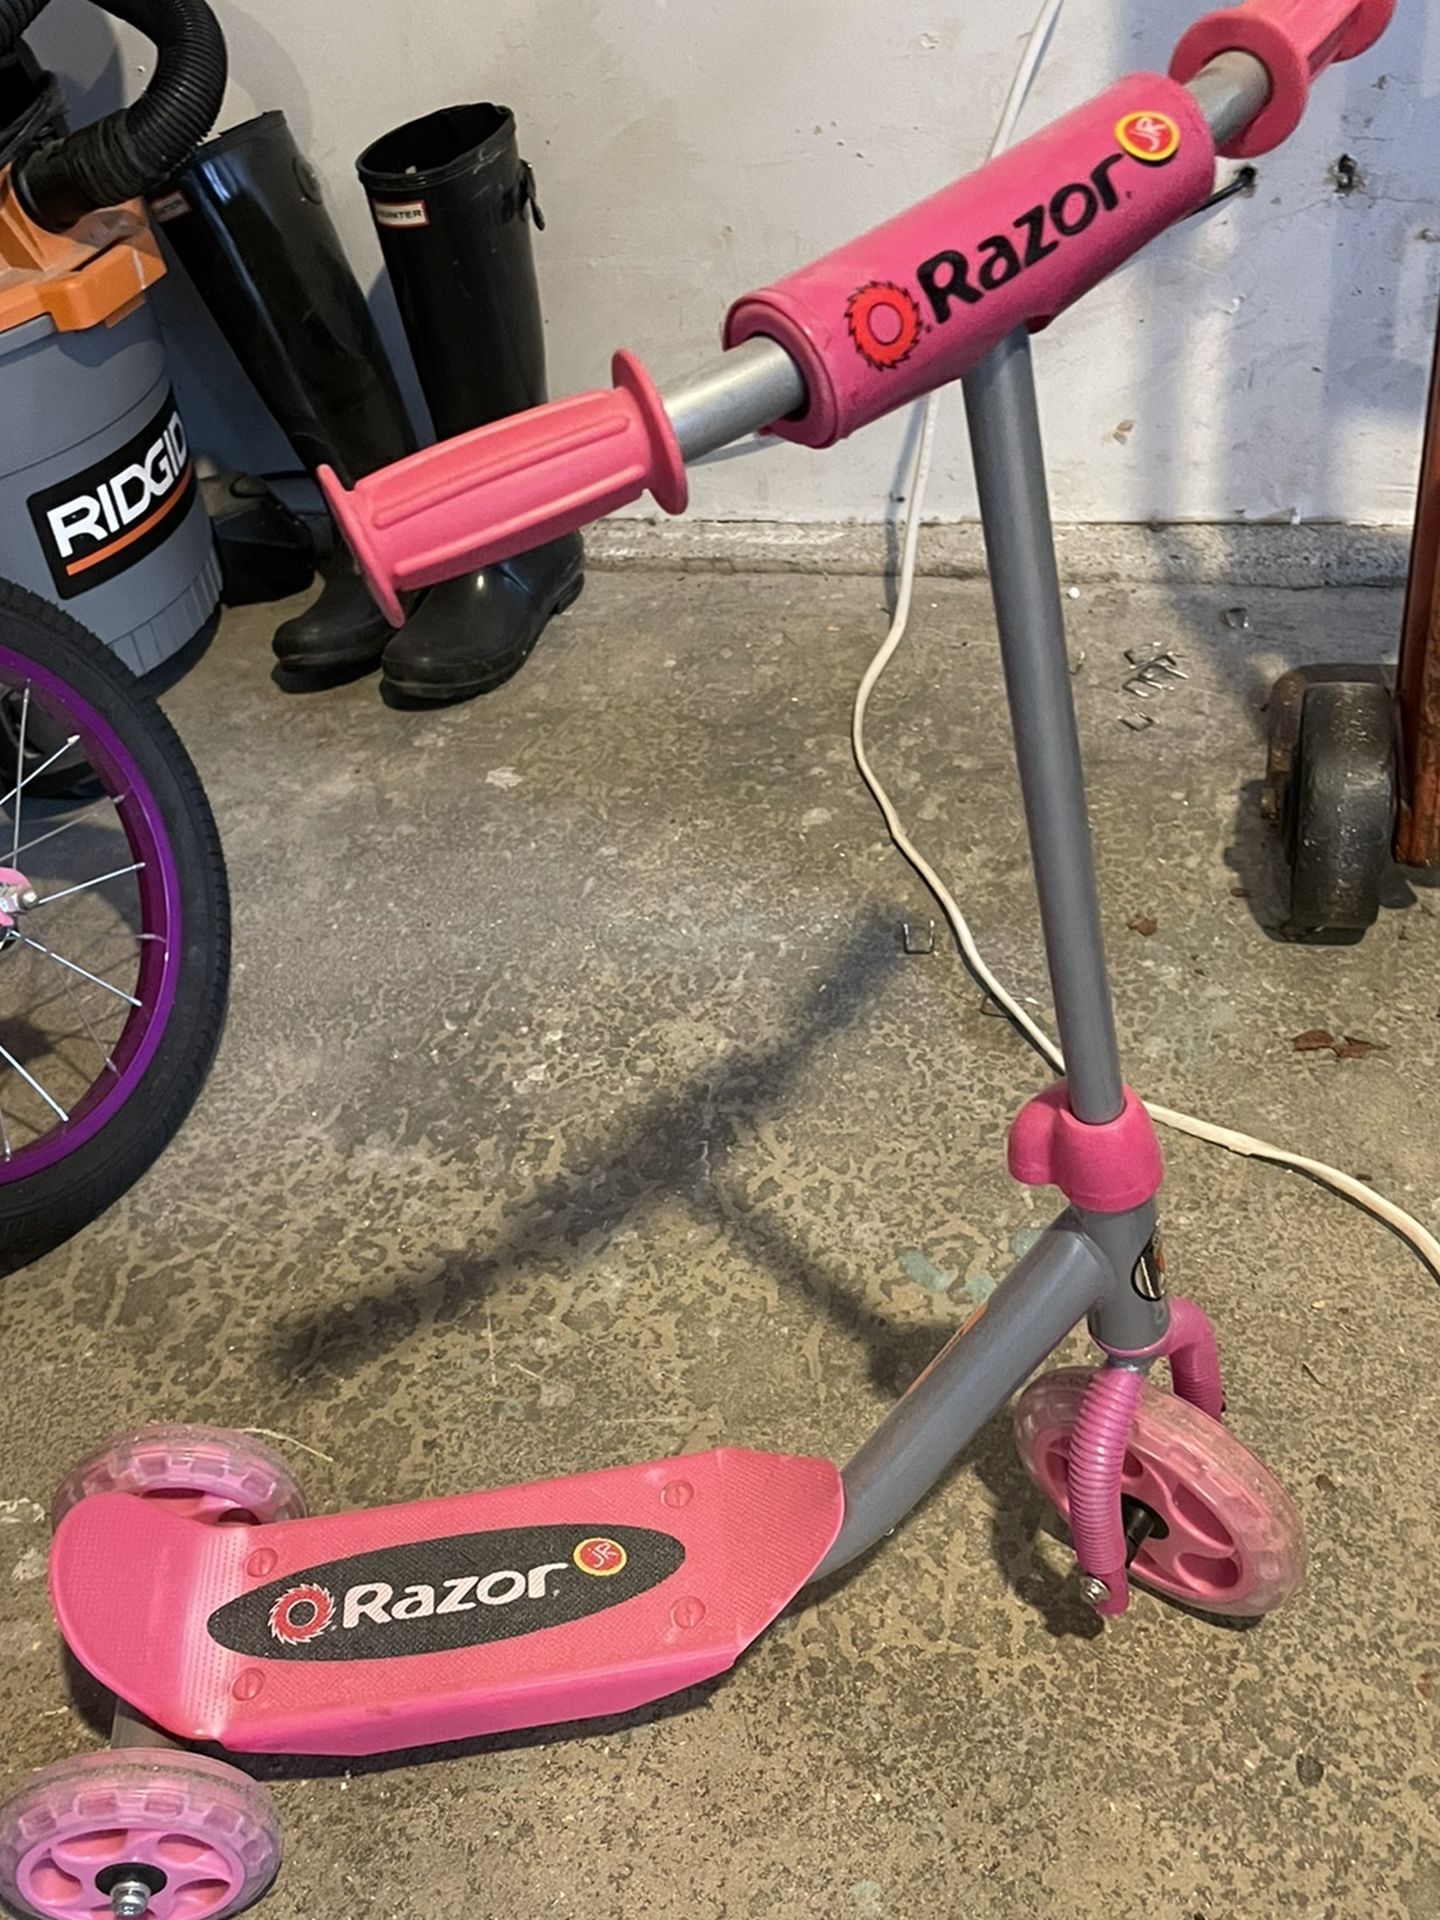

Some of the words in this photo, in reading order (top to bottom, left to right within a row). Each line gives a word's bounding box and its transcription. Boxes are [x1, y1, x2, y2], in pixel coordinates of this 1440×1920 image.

[916, 152, 1124, 325] Razor
[46, 410, 188, 559] RIDGID
[342, 1562, 570, 1630] Razor
